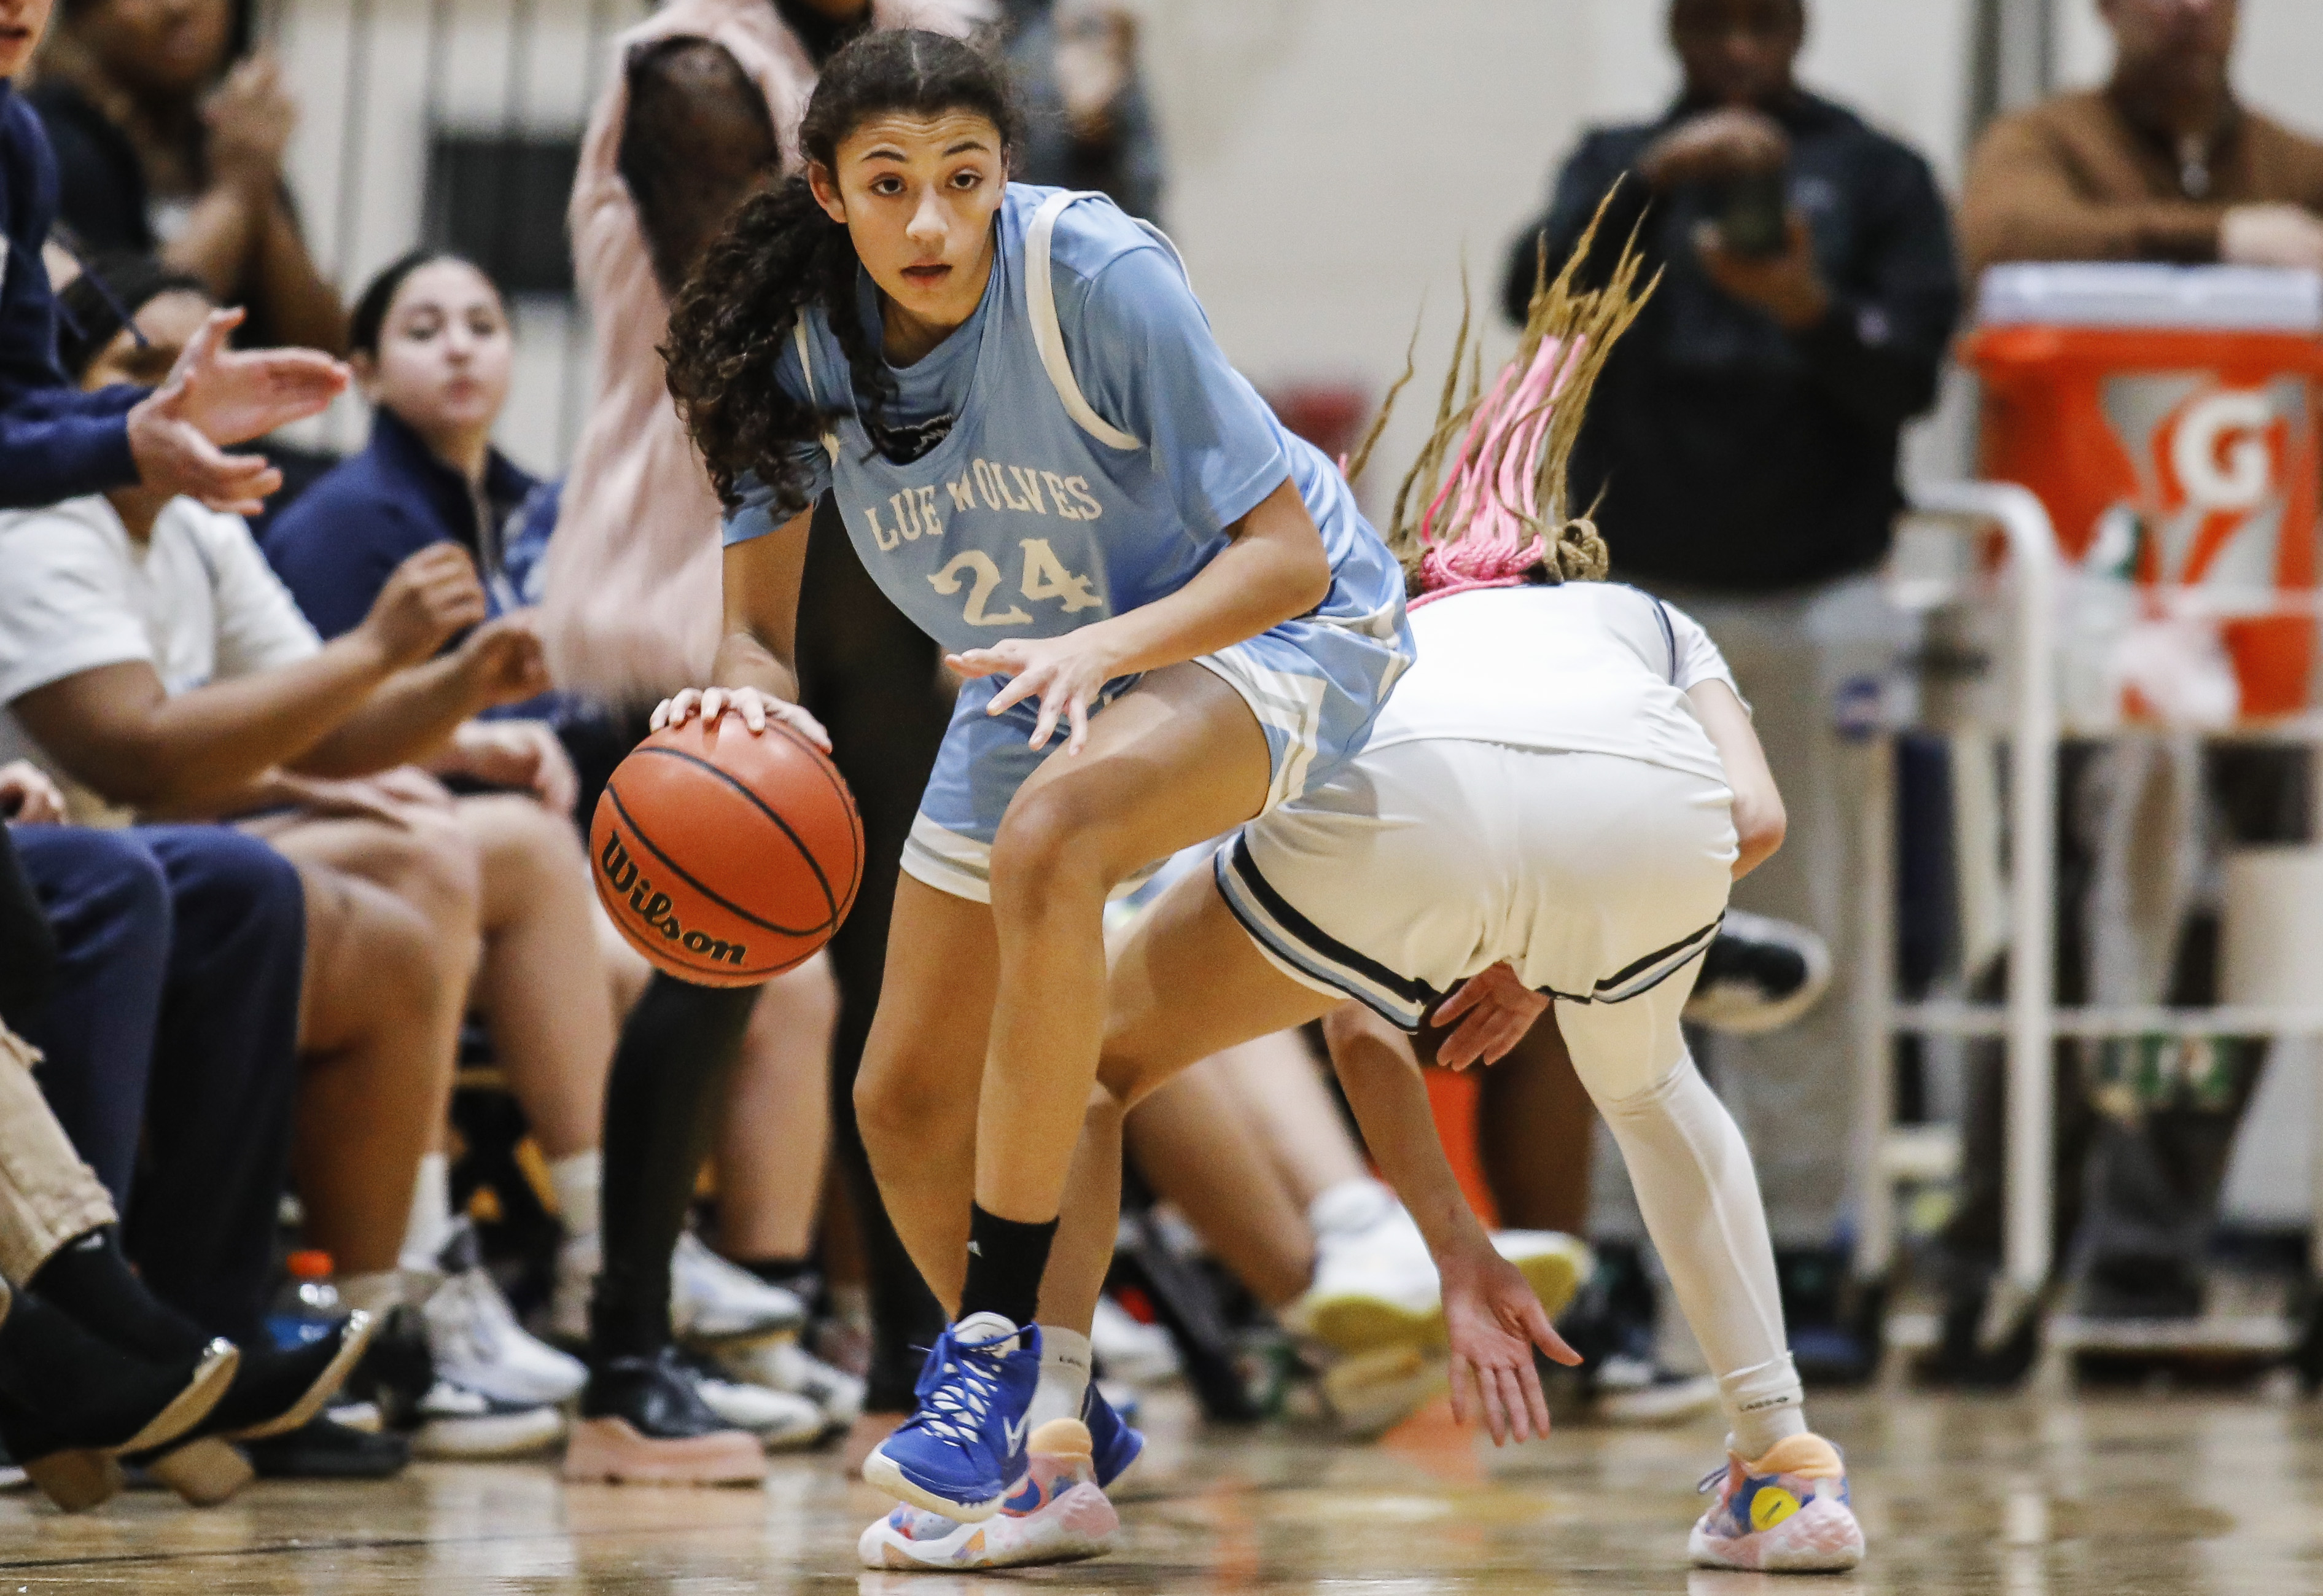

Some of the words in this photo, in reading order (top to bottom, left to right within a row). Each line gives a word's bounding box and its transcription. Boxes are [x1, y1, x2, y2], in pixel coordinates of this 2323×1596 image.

[2174, 391, 2270, 507] G
[927, 539, 1102, 626] 24
[601, 829, 747, 965] Wilson
